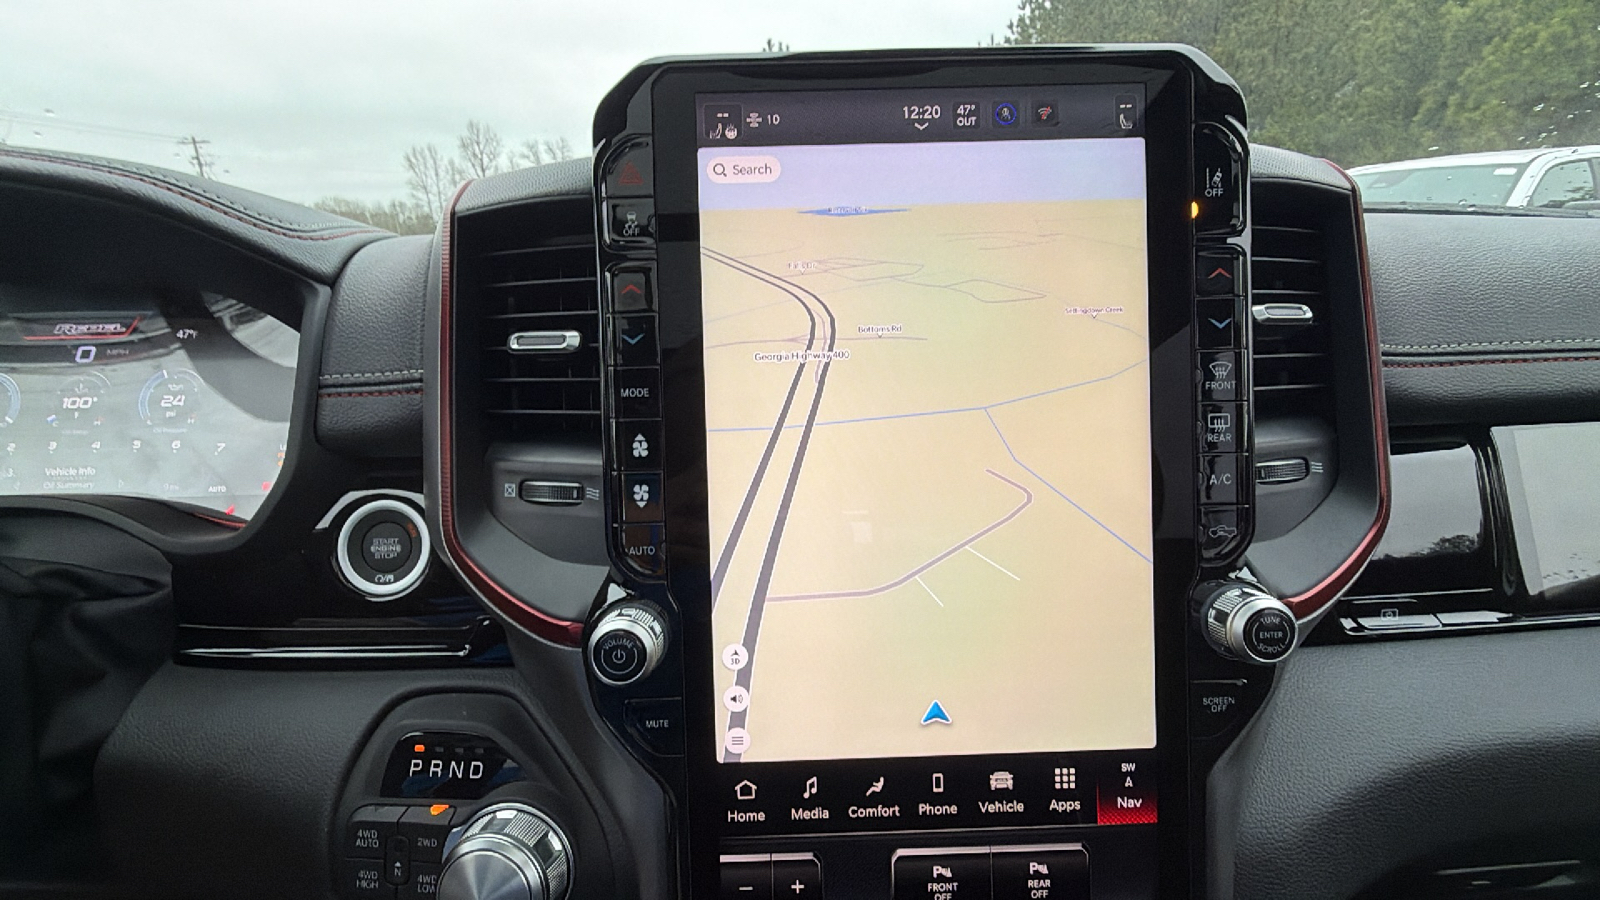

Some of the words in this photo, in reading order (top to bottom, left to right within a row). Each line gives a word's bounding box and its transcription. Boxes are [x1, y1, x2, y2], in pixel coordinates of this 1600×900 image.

[902, 104, 941, 119] 12:20
[956, 104, 976, 115] 47°
[956, 116, 977, 126] OUT
[732, 163, 772, 176] Search
[1205, 187, 1224, 198] OFF
[623, 227, 640, 236] OFF
[891, 325, 902, 333] Rd
[75, 346, 97, 363] 0
[754, 351, 790, 364] Georgia
[791, 350, 831, 363] Highway
[832, 350, 850, 360] 400
[1205, 380, 1236, 390] FRONT
[620, 387, 649, 398] MODE
[160, 394, 186, 407] 24
[1207, 432, 1232, 442] REAR
[171, 440, 181, 449] 6
[44, 467, 77, 476] Vehicle
[78, 466, 96, 475] Info
[1209, 474, 1232, 485] A/C
[208, 485, 226, 493] AUTO
[372, 538, 399, 546] START
[374, 551, 397, 560] STOP
[628, 545, 656, 556] AUTO
[1260, 616, 1281, 625] TUNE
[1259, 631, 1283, 639] ENTER
[603, 637, 634, 650] VOLUME
[1257, 643, 1286, 654] SCROLL
[730, 657, 741, 665] 3D
[1202, 697, 1235, 706] SCREEN
[1211, 704, 1227, 713] OFF
[645, 719, 669, 729] MUTE
[1121, 762, 1136, 772] SW
[978, 799, 1025, 813] Vehicle
[1049, 798, 1081, 813] Apps
[1116, 796, 1143, 809] Nav
[791, 806, 830, 820] Media
[848, 804, 900, 819] Comfort
[918, 802, 958, 816] Phone
[727, 809, 766, 823] Home
[357, 829, 378, 839] 4WD
[355, 838, 379, 848] AUTO
[417, 837, 438, 847] 2WD
[358, 870, 379, 880] 4WD
[394, 868, 402, 876] N
[356, 879, 379, 890] HIGH
[927, 882, 959, 893] FRONT
[1027, 879, 1051, 889] REAR
[934, 892, 953, 900] OFF
[1030, 889, 1049, 899] OFF
